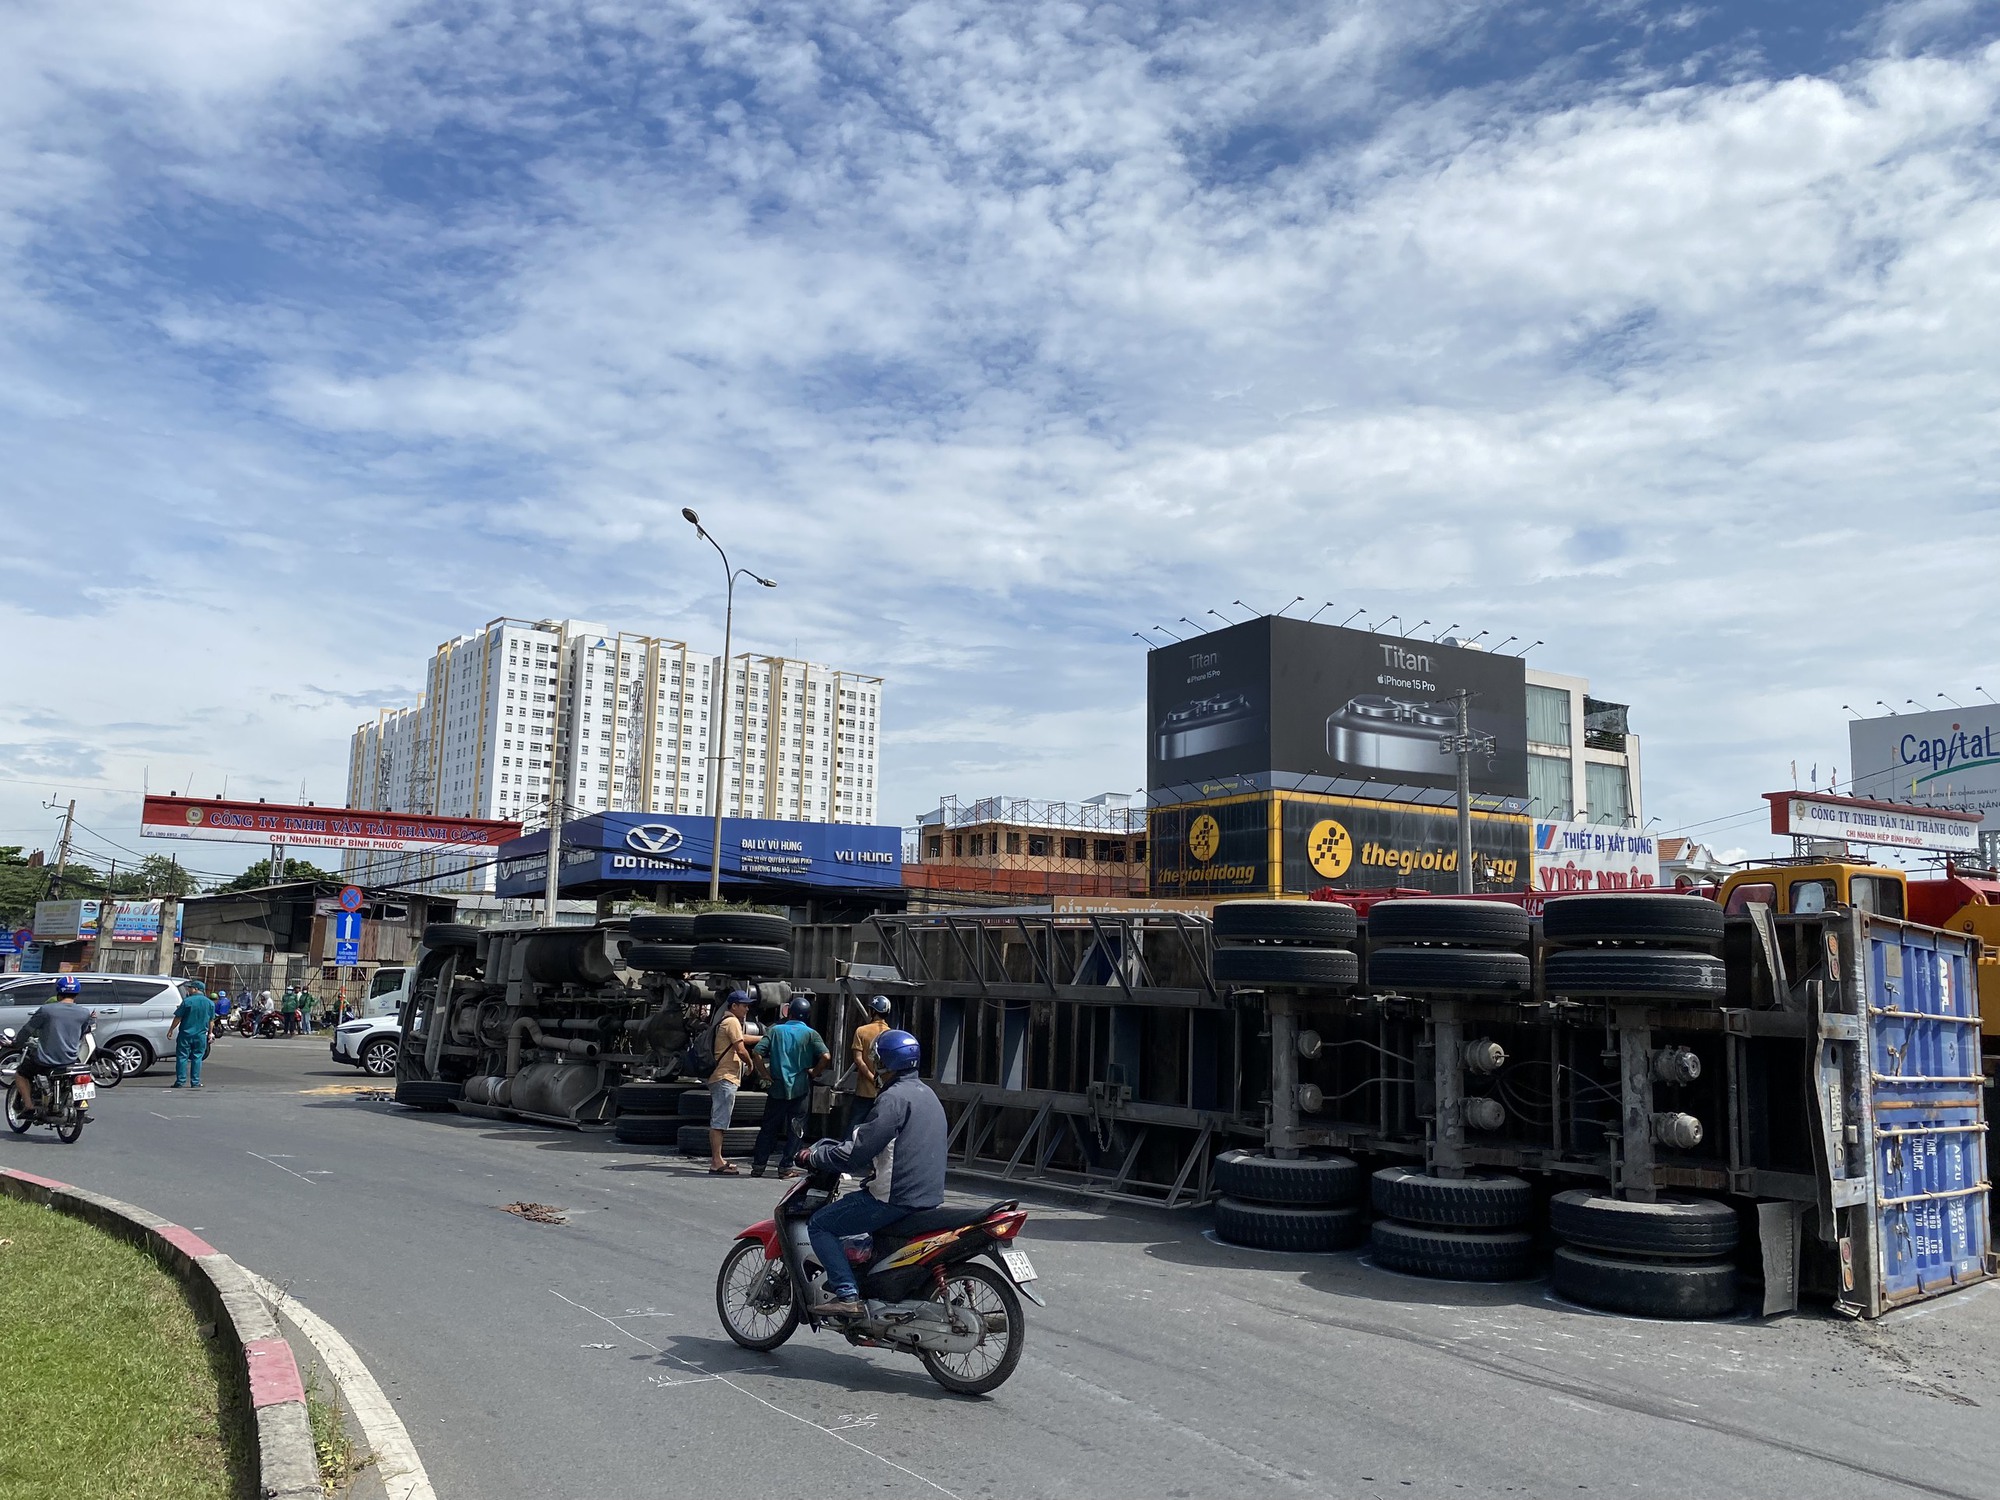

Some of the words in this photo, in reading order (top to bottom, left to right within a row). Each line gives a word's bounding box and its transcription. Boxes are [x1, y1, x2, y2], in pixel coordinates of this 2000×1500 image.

[1188, 652, 1217, 670] Titan
[1379, 643, 1430, 673] Titan
[1384, 675, 1412, 689] iPhone
[1412, 679, 1421, 690] 15
[1422, 680, 1436, 692] Pro
[210, 810, 254, 828] CÔNG
[258, 816, 281, 828] TY
[284, 817, 327, 832] TNHH
[331, 818, 362, 837] VẬN
[366, 819, 392, 837] TẢI
[397, 820, 448, 840] THÀNH
[451, 825, 488, 843] CÔNG
[1811, 805, 1835, 822] CÔNG
[1838, 810, 1849, 823] TY
[1854, 812, 1877, 827] TNHH
[1879, 813, 1897, 831] VẬN
[1900, 815, 1914, 831] TẢI
[1917, 818, 1946, 835] THÀNH
[1948, 821, 1970, 838] CÔNG
[269, 834, 286, 843] CHI
[289, 834, 322, 845] NHÁNH
[323, 837, 345, 847] HIỆP
[348, 837, 370, 848] BÌNH
[373, 839, 404, 850] PHƯỚC
[741, 838, 755, 851] ĐẠI
[757, 837, 767, 850] LÝ
[767, 838, 779, 850] VŨ
[780, 838, 802, 851] HÙNG
[835, 848, 854, 863] VŨ
[857, 849, 893, 863] HÙNG
[1563, 828, 1592, 850] THIẾT
[1595, 834, 1605, 853] BỊ
[1608, 832, 1625, 853] XÂY
[1628, 836, 1653, 856] DỰNG
[1939, 957, 1950, 1012] APL
[1953, 1145, 1962, 1181] APZU
